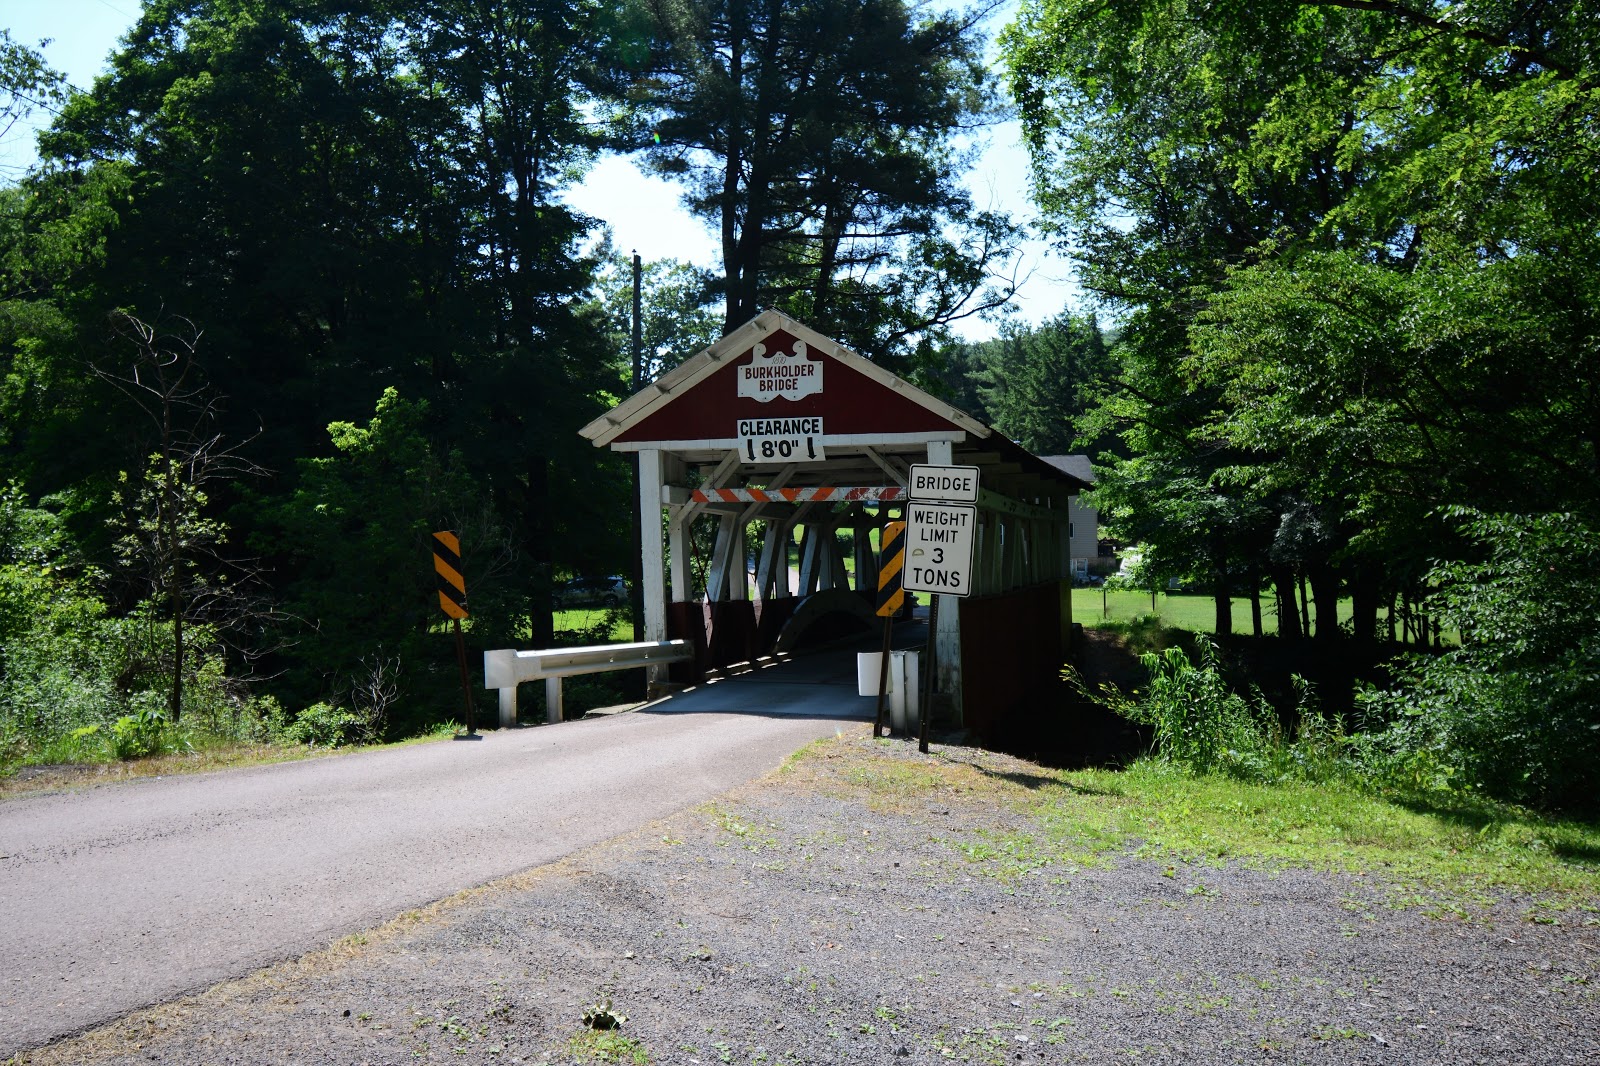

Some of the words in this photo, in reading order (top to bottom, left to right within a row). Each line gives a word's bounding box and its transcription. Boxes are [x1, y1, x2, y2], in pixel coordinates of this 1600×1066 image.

[745, 365, 814, 379] BURKHOLDER
[759, 379, 798, 391] BRIDGE
[740, 419, 820, 436] CLEARANCE
[761, 440, 799, 458] 8'0"
[916, 476, 971, 491] BRIDGE
[914, 511, 968, 526] WEIGHT
[920, 528, 958, 543] LIMIT
[932, 548, 944, 564] 3
[913, 568, 960, 587] TONS
